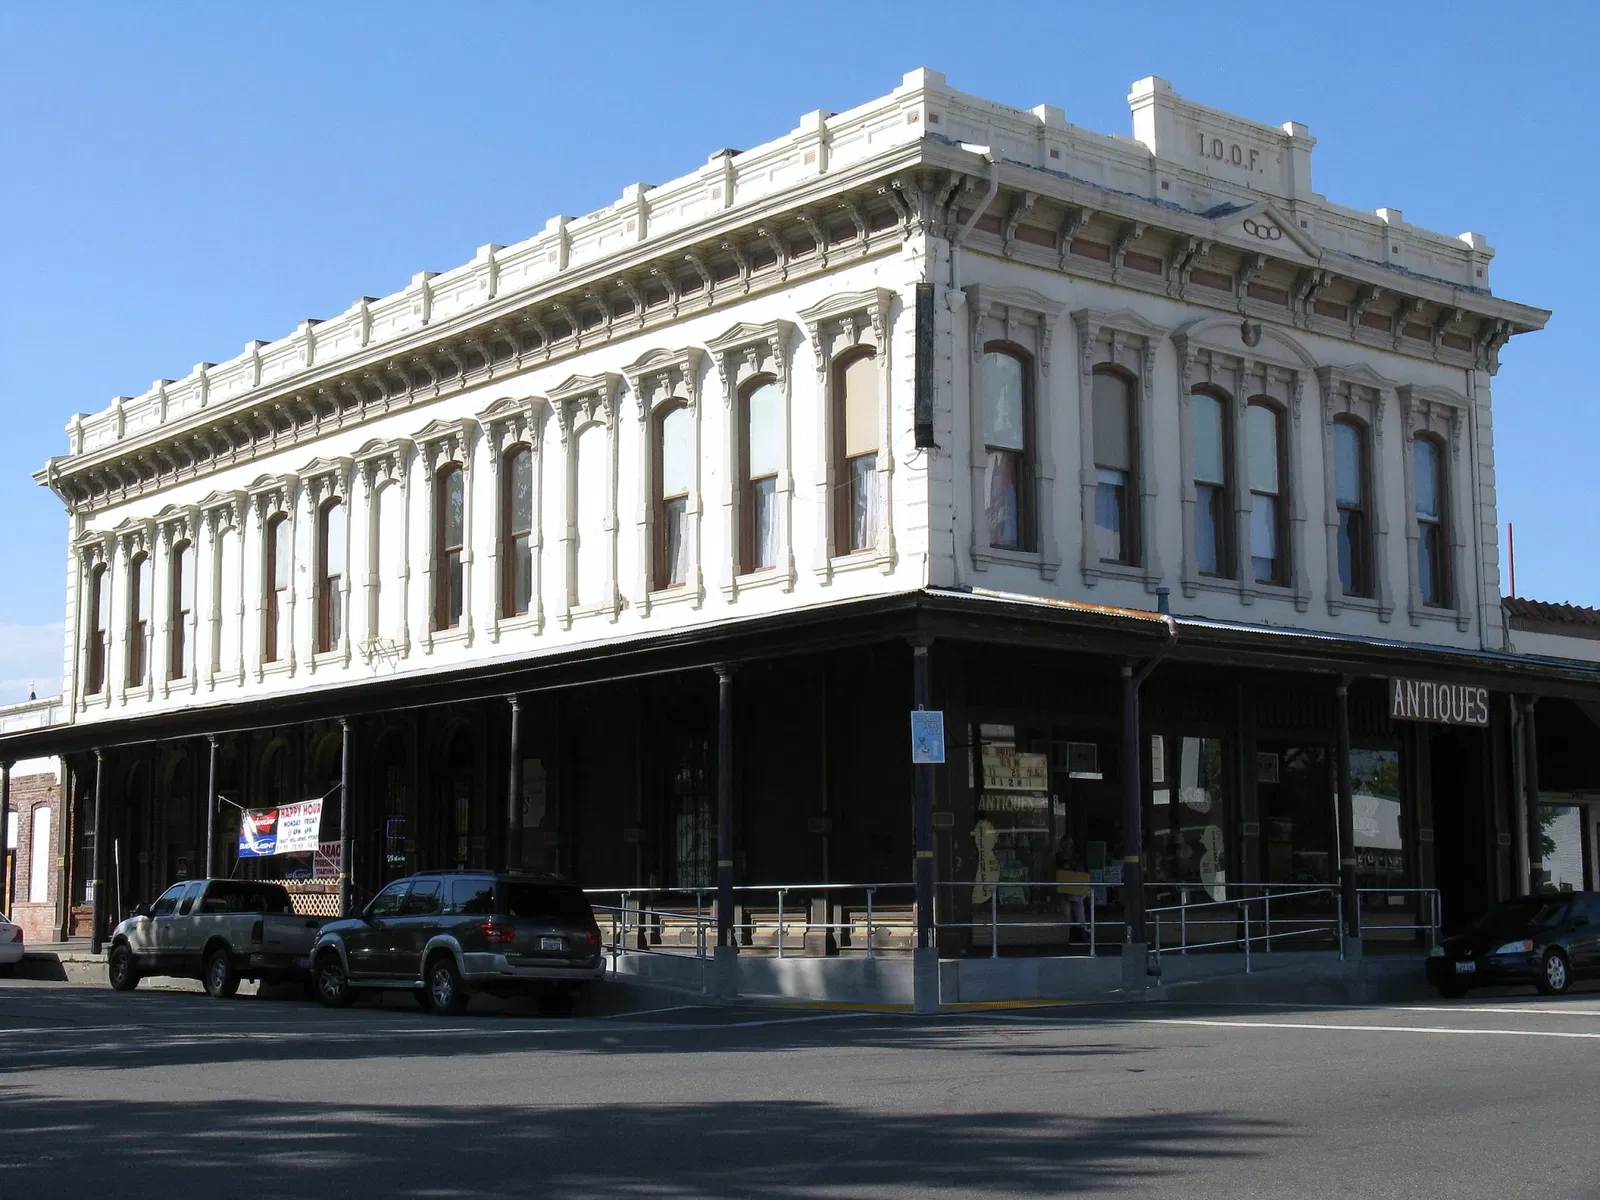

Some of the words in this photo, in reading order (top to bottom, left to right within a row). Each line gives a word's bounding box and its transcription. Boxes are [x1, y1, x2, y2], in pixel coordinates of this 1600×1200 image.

[1393, 679, 1488, 724] ANTIQUES
[280, 806, 301, 819] HAPPY
[303, 802, 321, 816] HOUR
[978, 794, 1034, 812] ANTIQUES
[284, 819, 301, 827] MONDAY
[304, 817, 318, 825] FRIDAY
